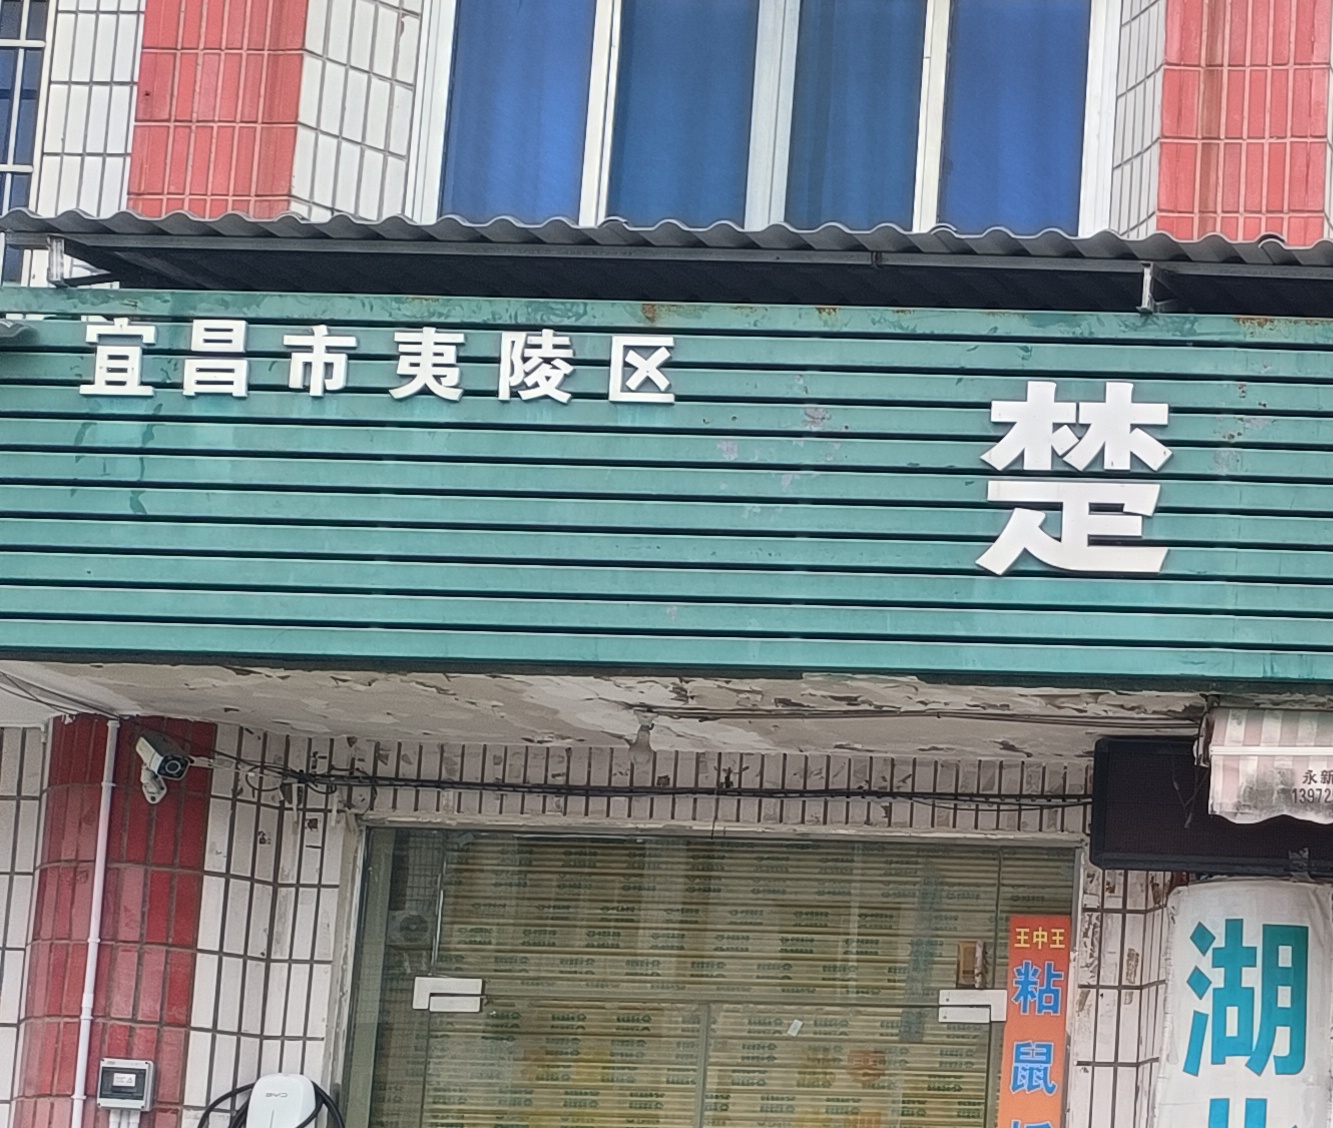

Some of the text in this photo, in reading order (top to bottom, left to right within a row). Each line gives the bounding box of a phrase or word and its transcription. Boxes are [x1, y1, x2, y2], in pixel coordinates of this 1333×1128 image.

[80, 317, 676, 404] 宜昌市夷陵区
[1014, 927, 1066, 950] 王中王
